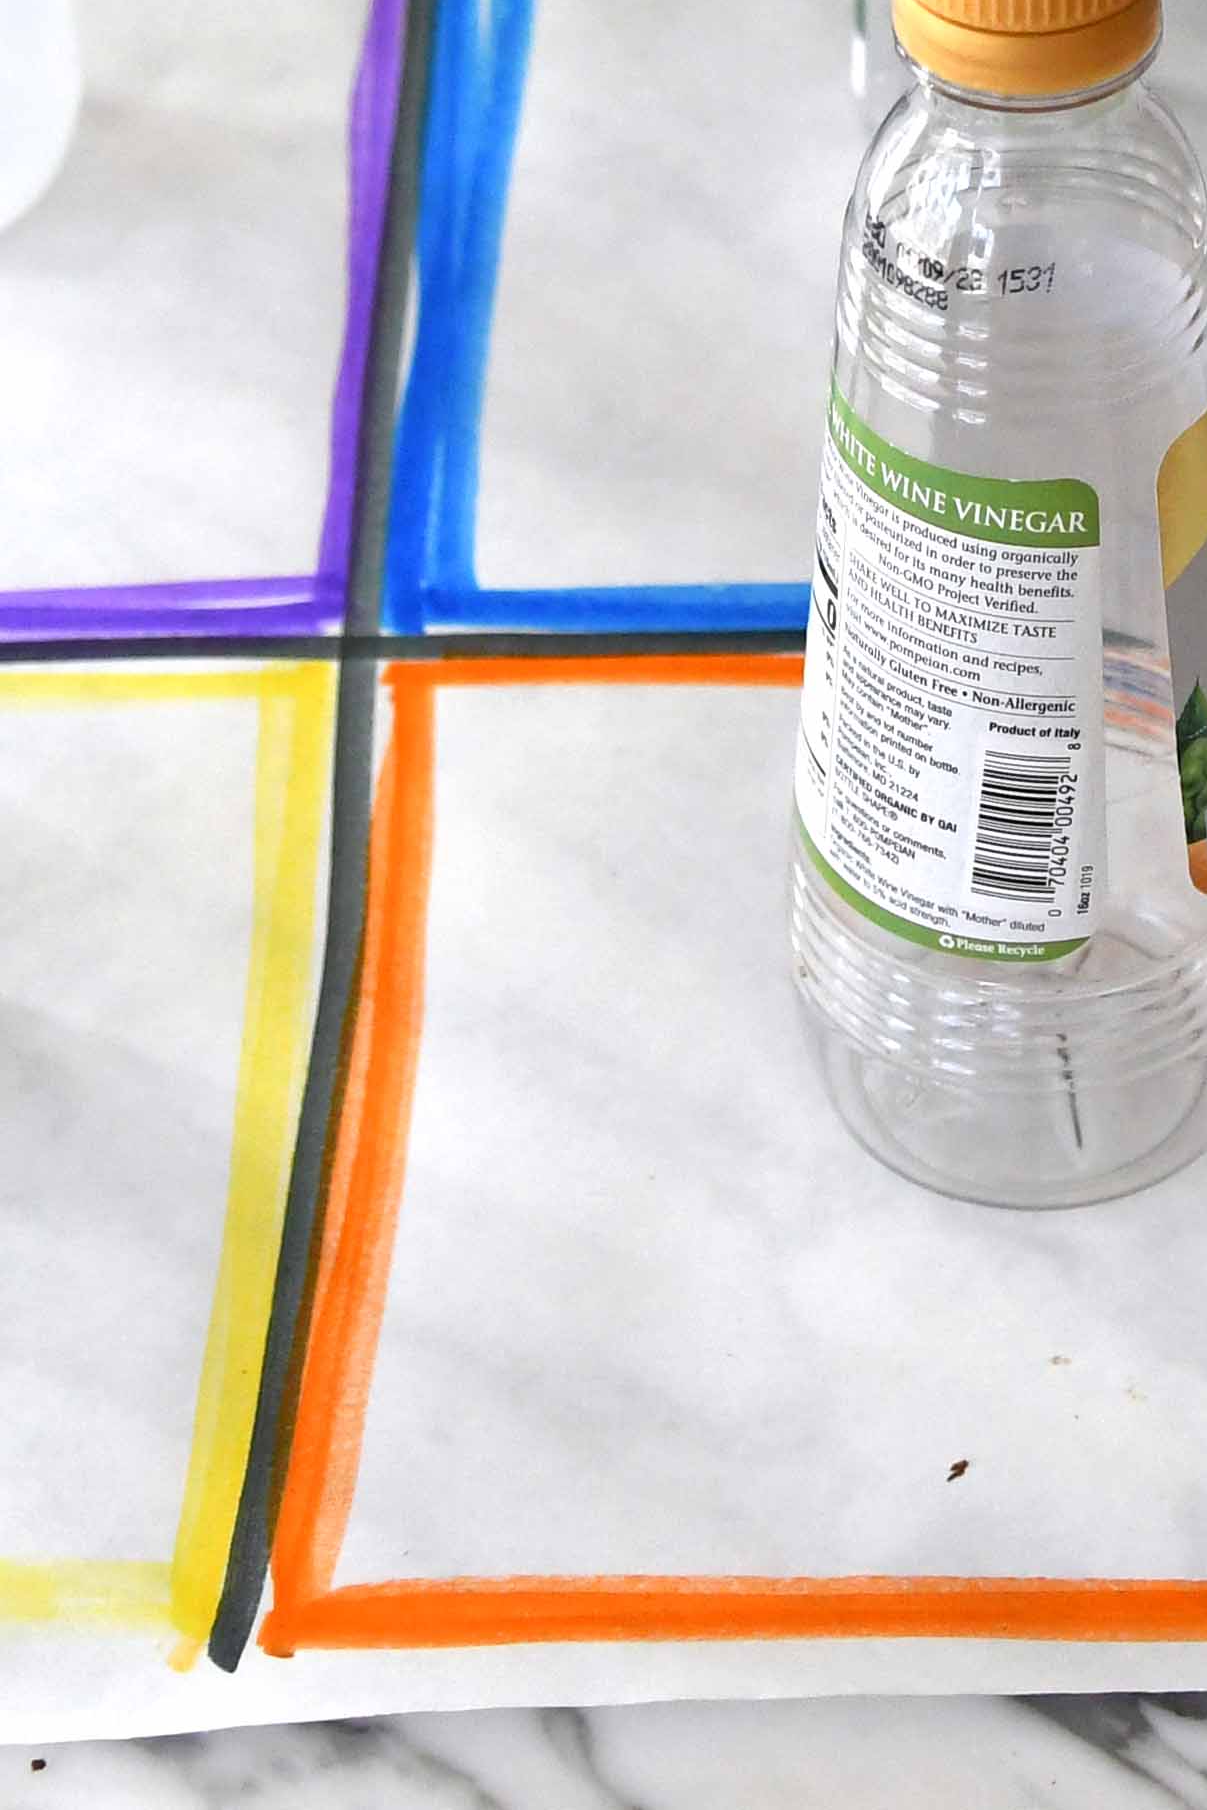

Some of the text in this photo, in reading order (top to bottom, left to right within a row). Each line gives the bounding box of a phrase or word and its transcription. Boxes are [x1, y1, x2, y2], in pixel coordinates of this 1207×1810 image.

[881, 461, 947, 515] WINE
[952, 496, 1088, 534] VINEGAR
[860, 523, 891, 553] desired
[894, 546, 909, 563] for
[913, 556, 926, 571] its
[930, 565, 966, 587] many
[970, 575, 1014, 595] health
[1018, 583, 1075, 599] benefits.
[866, 511, 922, 552] pasteurized
[926, 545, 937, 559] in
[941, 554, 976, 571] order
[980, 563, 992, 574] to
[996, 566, 1051, 582] preserve
[1056, 569, 1078, 581] the
[892, 510, 899, 524] is
[902, 519, 957, 549] produced
[961, 540, 997, 561] using
[1001, 550, 1079, 567] organically
[879, 553, 1039, 614] Non-GMO Project Verified.
[870, 586, 914, 622] HEALTH
[918, 614, 978, 644] BENEFITS
[880, 577, 910, 605] WELL
[914, 597, 932, 613] TO
[935, 605, 1009, 634] MAXIMIZE
[1012, 624, 1057, 639] TASTE
[863, 621, 981, 681] www.pompeian.com
[887, 621, 958, 661] information
[962, 654, 989, 668] and
[993, 661, 1043, 676] recipes,
[889, 659, 928, 686] Gluten
[932, 678, 958, 697] Free
[972, 690, 1076, 714] Non-Allergenic
[928, 700, 952, 717] taste
[896, 730, 933, 752] number
[904, 704, 925, 721] may
[927, 715, 951, 731] vary.
[988, 721, 1080, 739] Product of Italy
[881, 733, 912, 756] printed
[914, 752, 926, 763] on
[909, 763, 921, 778] by
[874, 789, 918, 819] ORGANIC
[920, 812, 935, 825] BY
[938, 819, 958, 833] QAI
[889, 780, 919, 802] 21224
[893, 831, 947, 860] comments,
[1048, 742, 1081, 917] 0 70404 00492 8
[900, 887, 935, 910] Vinegar
[937, 904, 958, 918] with
[961, 909, 1007, 928] "Mother"
[1009, 920, 1045, 932] diluted
[1076, 865, 1094, 915] 16oz 1019
[909, 906, 951, 928] strength.
[956, 938, 1045, 957] Please Recycle
